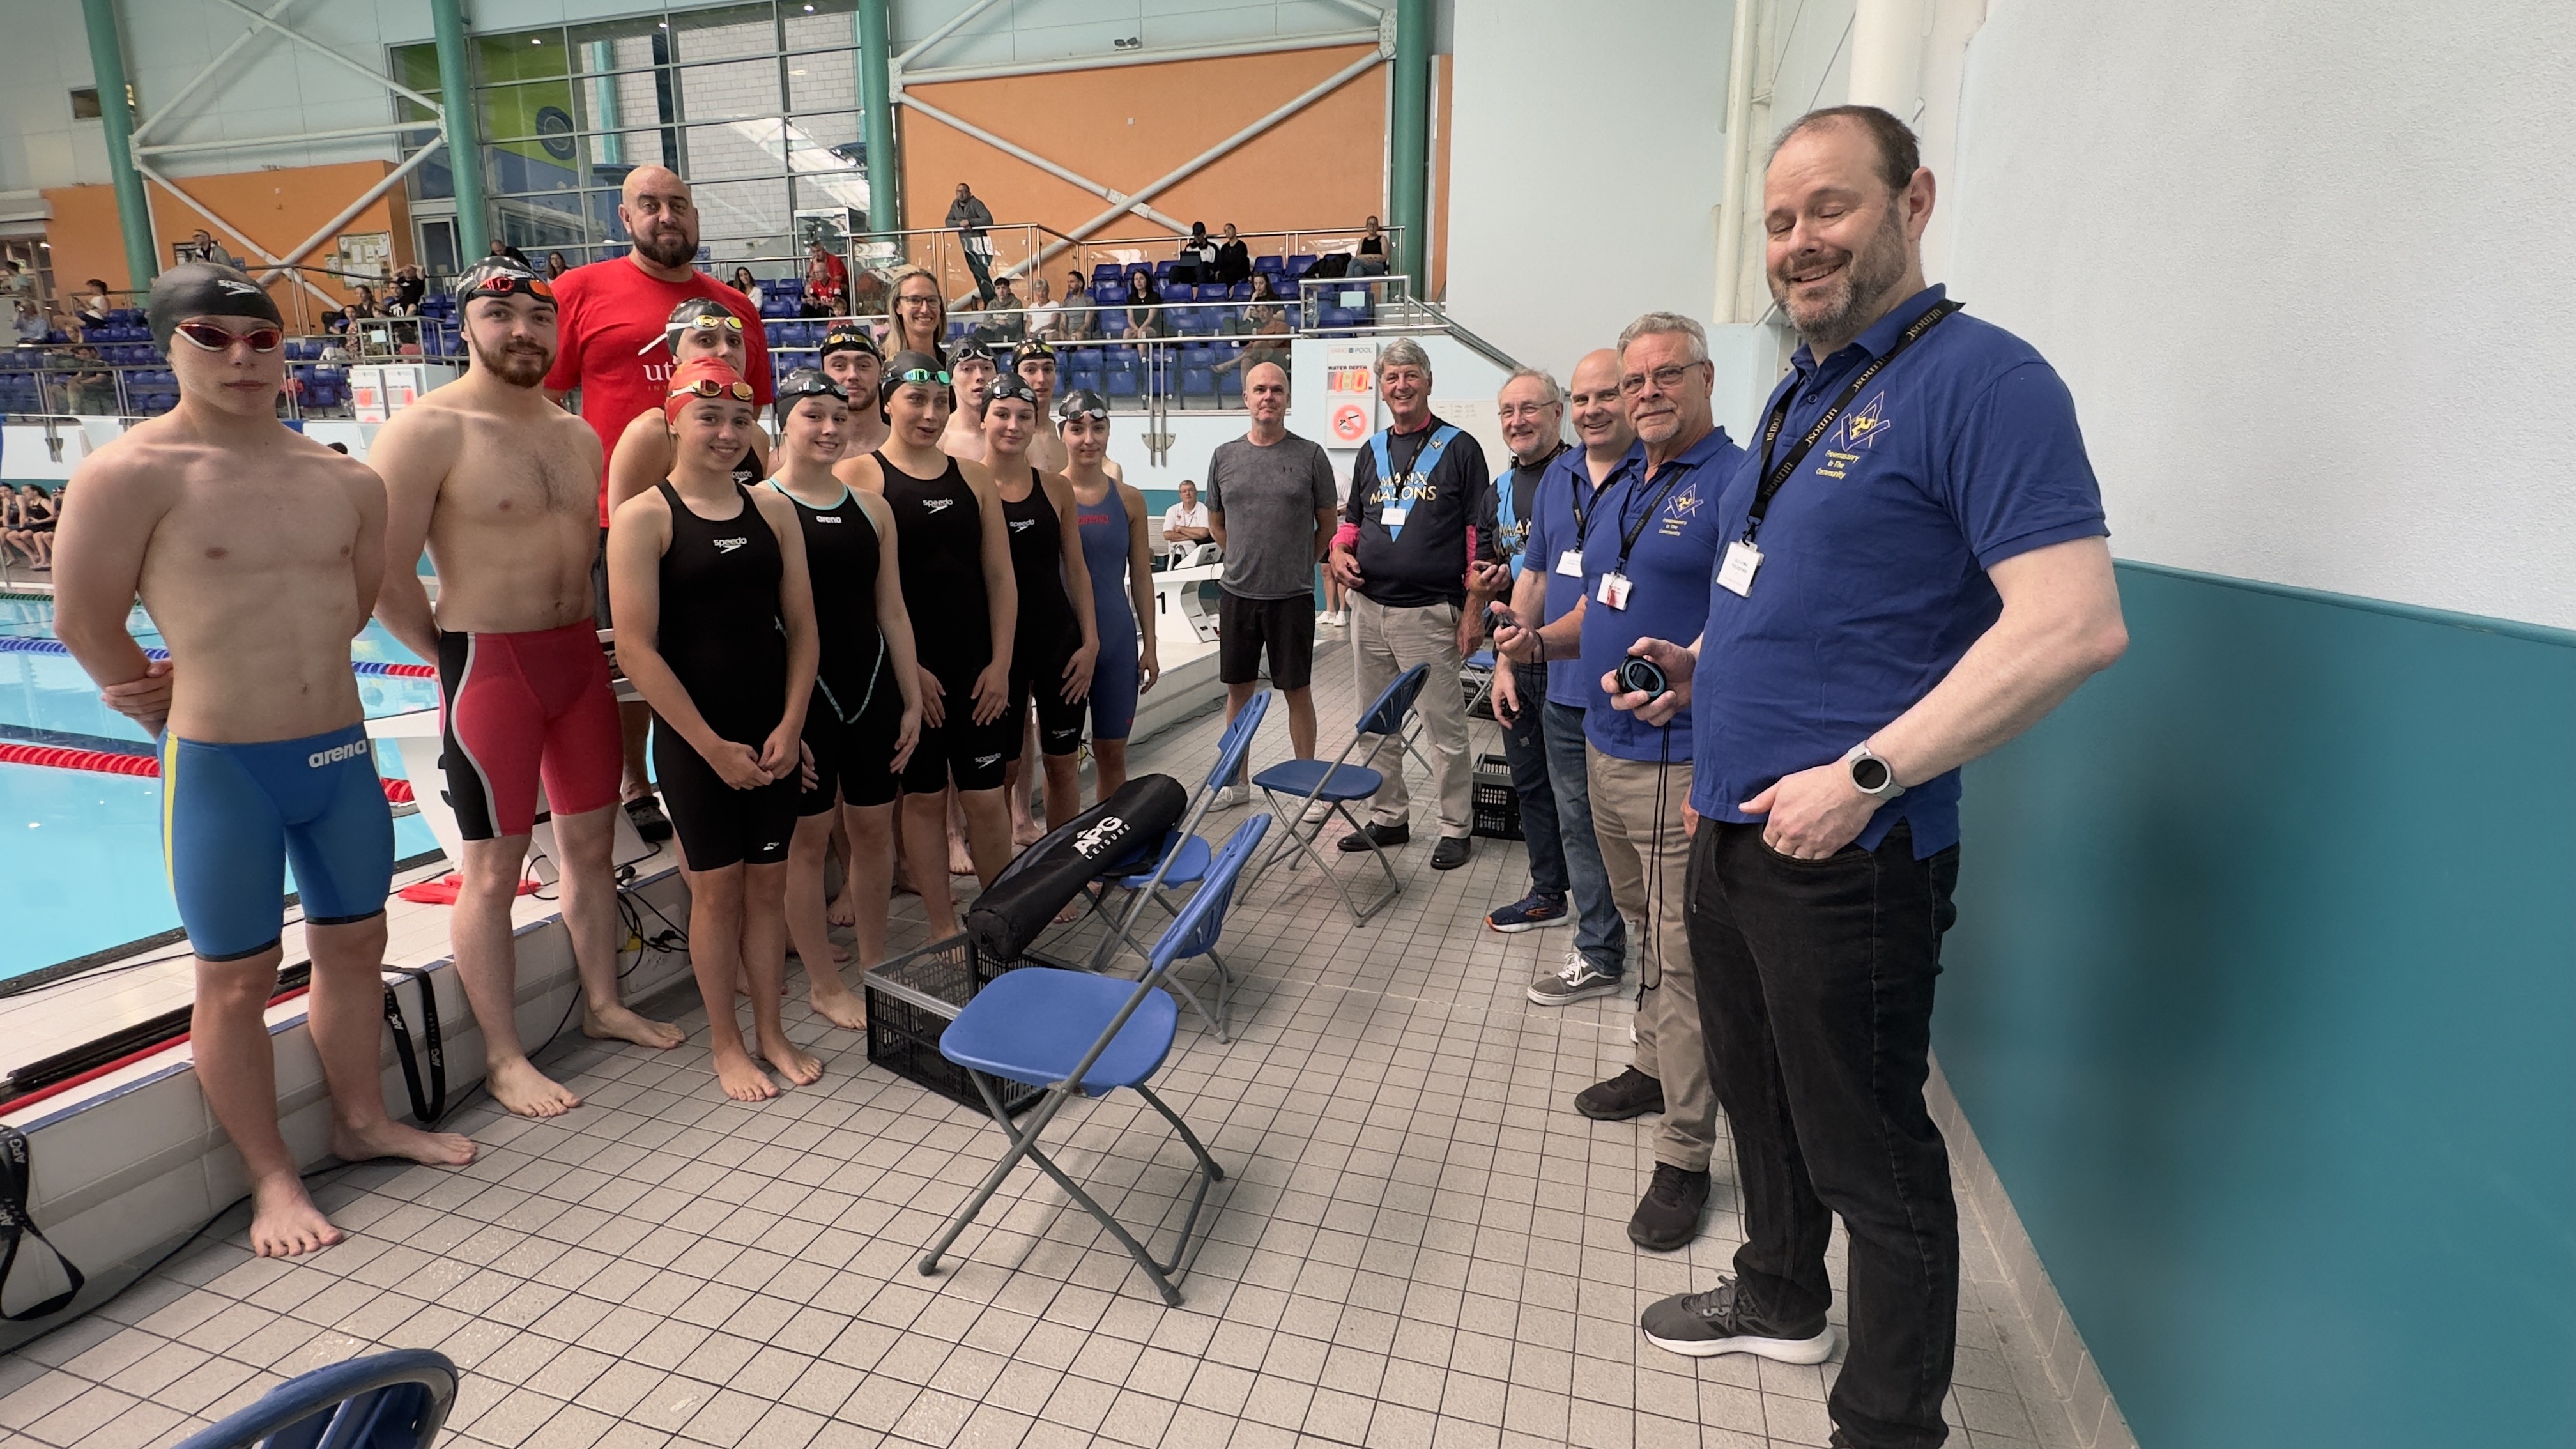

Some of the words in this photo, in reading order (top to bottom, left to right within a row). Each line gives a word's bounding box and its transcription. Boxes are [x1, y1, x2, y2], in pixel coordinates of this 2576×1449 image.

[1905, 309, 1942, 341] utmost
[1805, 408, 1838, 448] utmost
[731, 470, 753, 479] peedo
[923, 498, 953, 507] speedo
[816, 515, 842, 524] arena
[1009, 519, 1035, 528] speedo
[713, 537, 747, 548] speedo
[1156, 591, 1166, 614] 1
[309, 739, 367, 768] arena
[975, 753, 1001, 763] speedo
[1071, 816, 1123, 855] APG
[1085, 824, 1131, 860] LEISURE
[8, 1138, 26, 1163] APG
